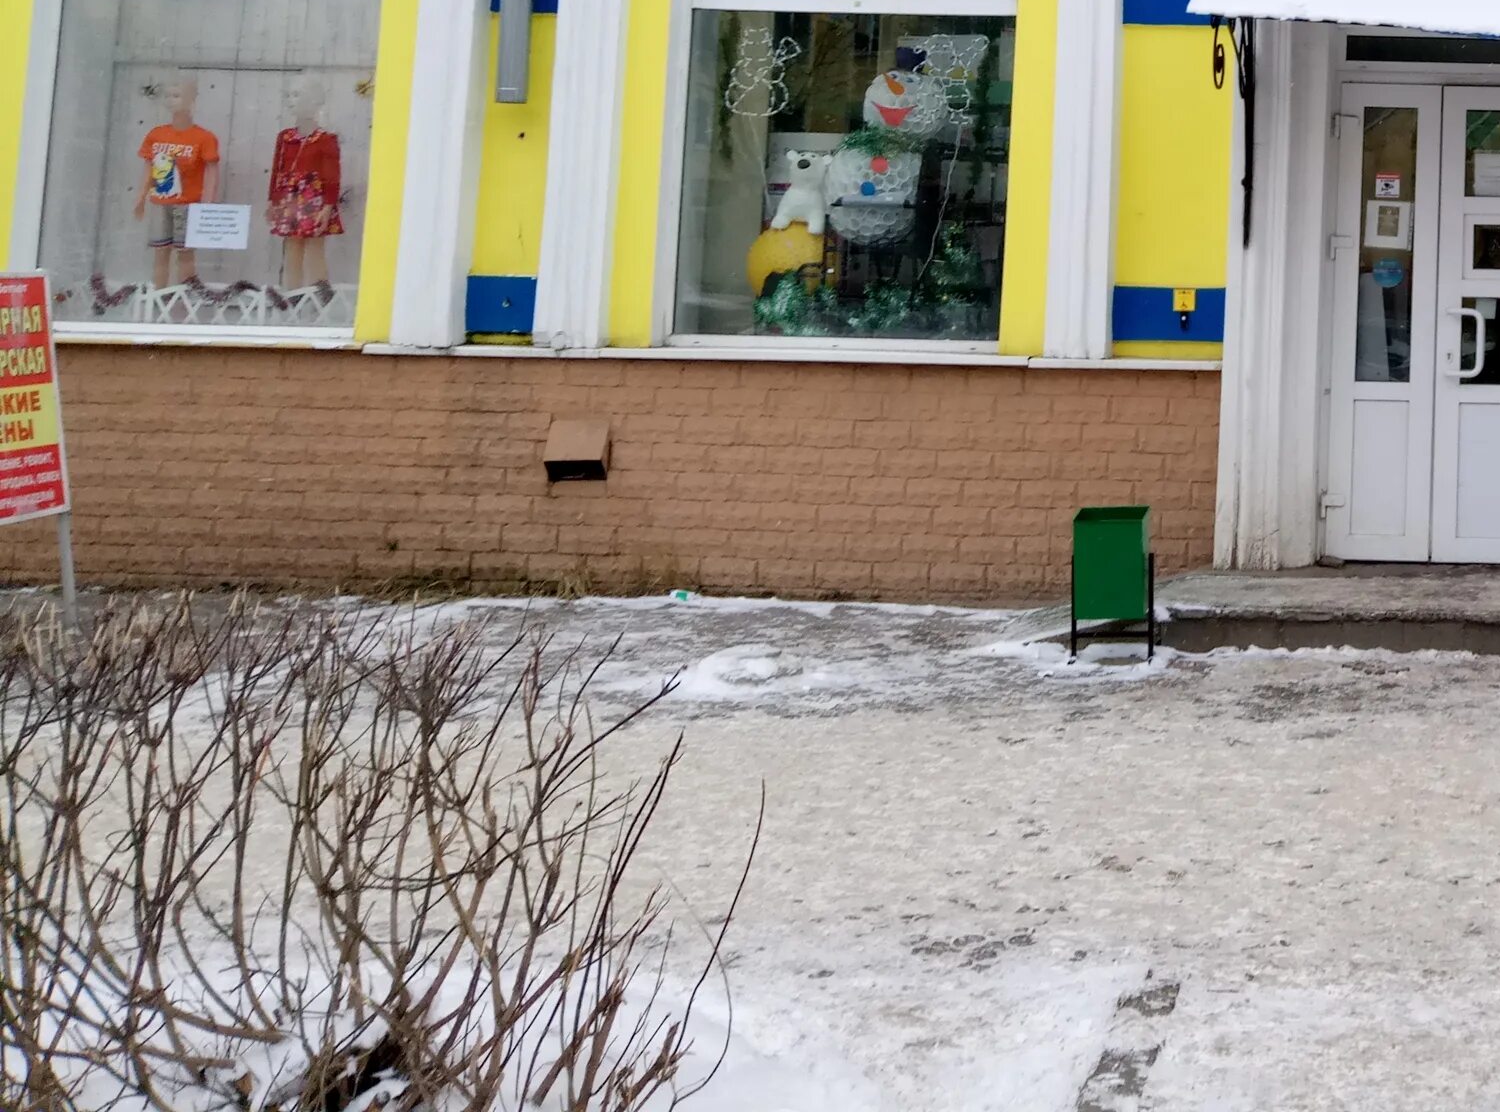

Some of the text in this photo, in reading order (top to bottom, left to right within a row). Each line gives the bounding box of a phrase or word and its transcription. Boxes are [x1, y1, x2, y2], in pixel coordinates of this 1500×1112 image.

[152, 142, 193, 157] SUPER
[0, 304, 42, 336] РНАЯ
[0, 390, 41, 416] КИЕ
